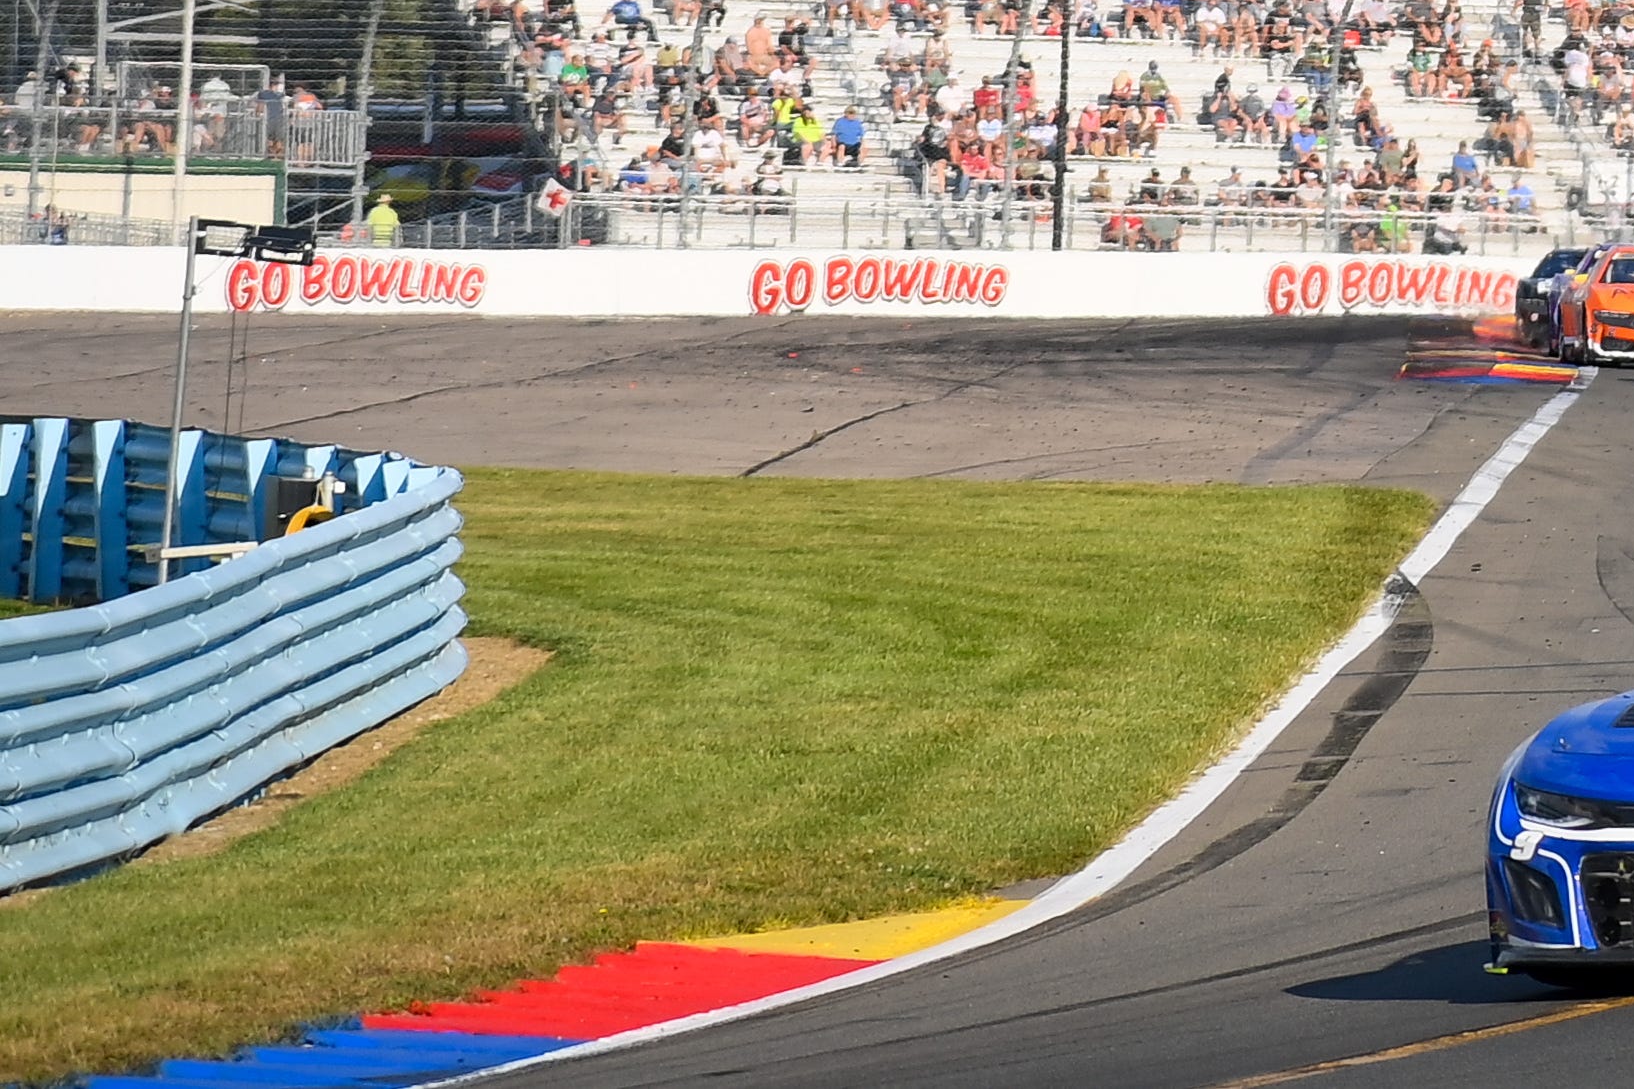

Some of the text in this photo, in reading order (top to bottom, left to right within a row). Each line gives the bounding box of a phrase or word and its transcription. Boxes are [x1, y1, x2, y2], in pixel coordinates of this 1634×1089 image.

[227, 255, 486, 312] GO BOWLING
[751, 257, 1008, 316] GO BOWLING
[1267, 260, 1517, 316] GO BOWLING
[1510, 830, 1545, 861] 9
